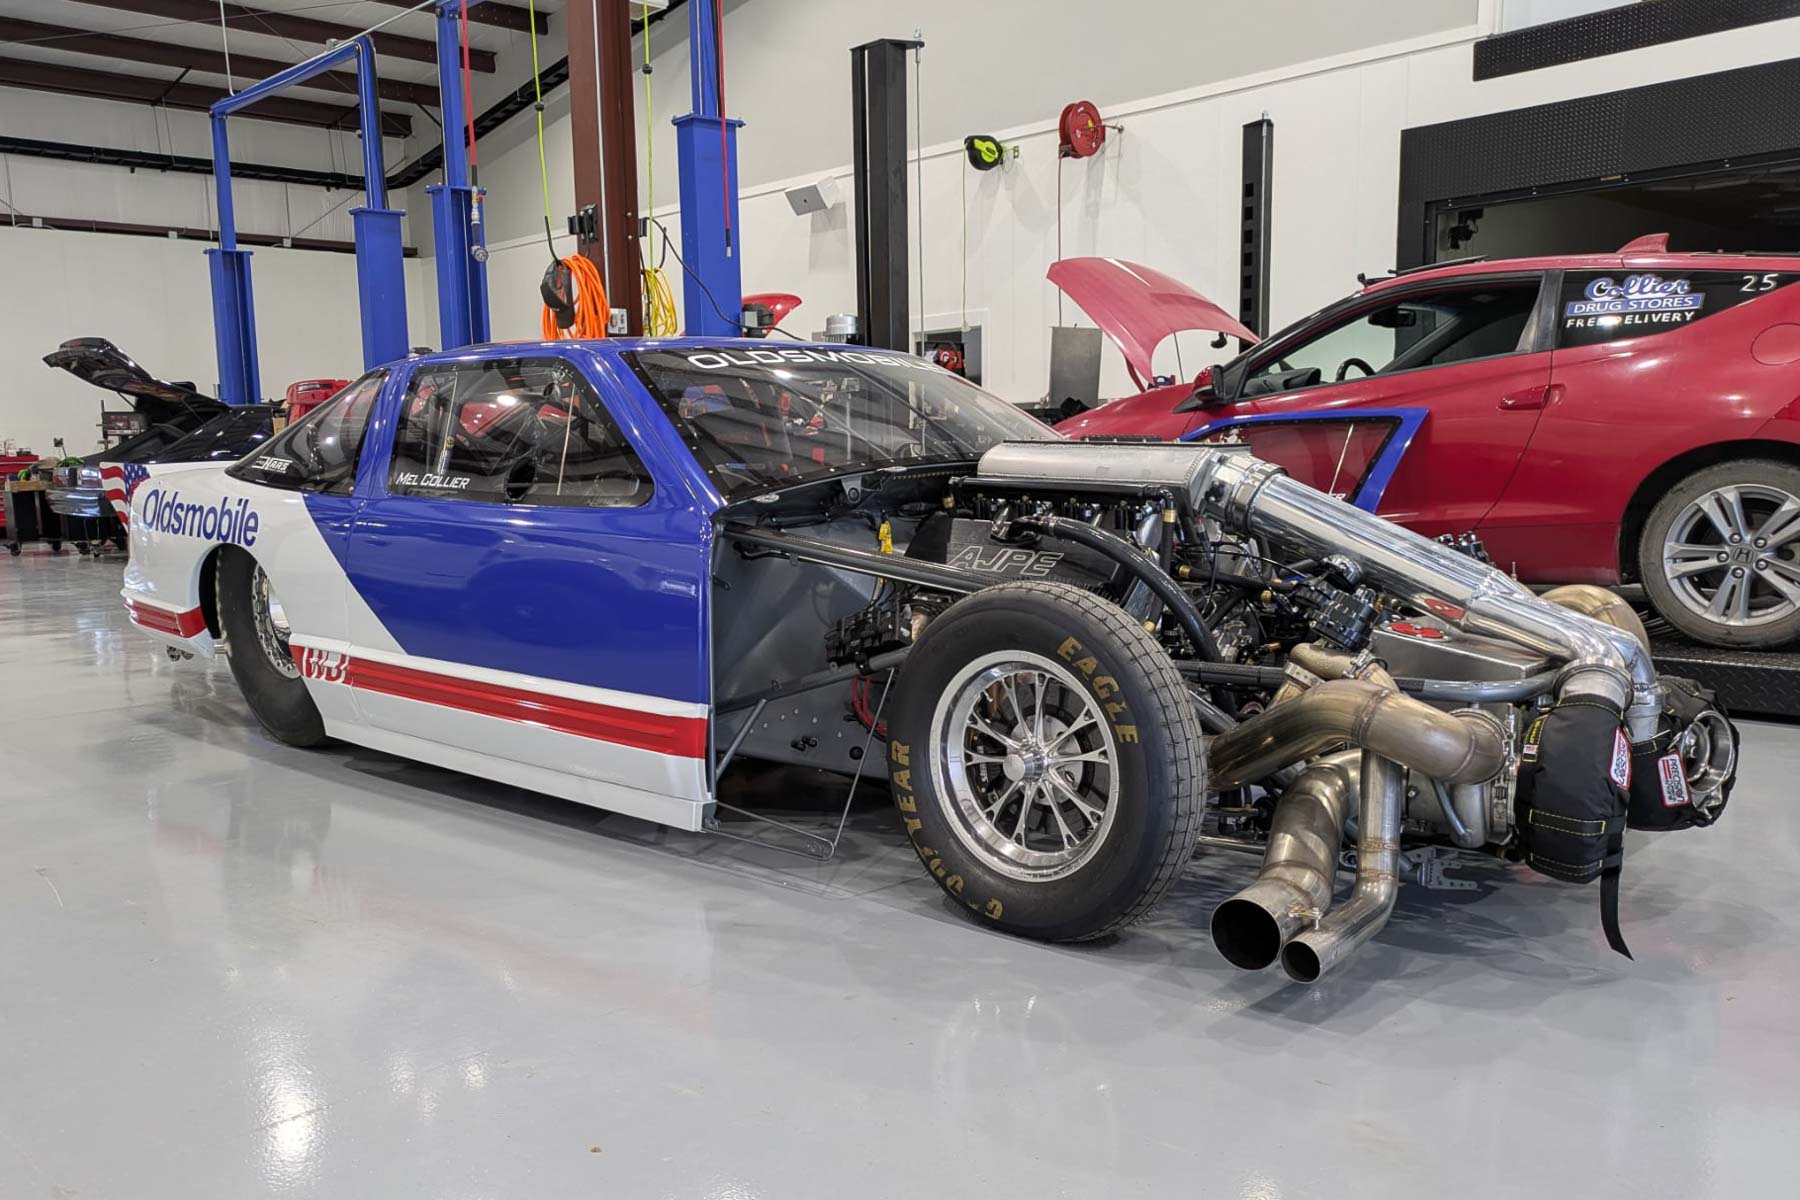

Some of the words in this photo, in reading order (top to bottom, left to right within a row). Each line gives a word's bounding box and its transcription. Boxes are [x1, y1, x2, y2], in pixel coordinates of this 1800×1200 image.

[1586, 275, 1690, 301] Collier
[1740, 273, 1779, 292] 25
[1573, 301, 1622, 314] DRUG
[1628, 296, 1694, 311] STORES
[1609, 311, 1695, 328] ELIVERY
[687, 349, 948, 376] OLDSMOBILE
[395, 472, 418, 486] MEL
[420, 473, 471, 489] COLLIER
[142, 489, 259, 547] Oldsmobile
[946, 545, 1065, 577] AJPE
[1056, 636, 1139, 744] EAGLE
